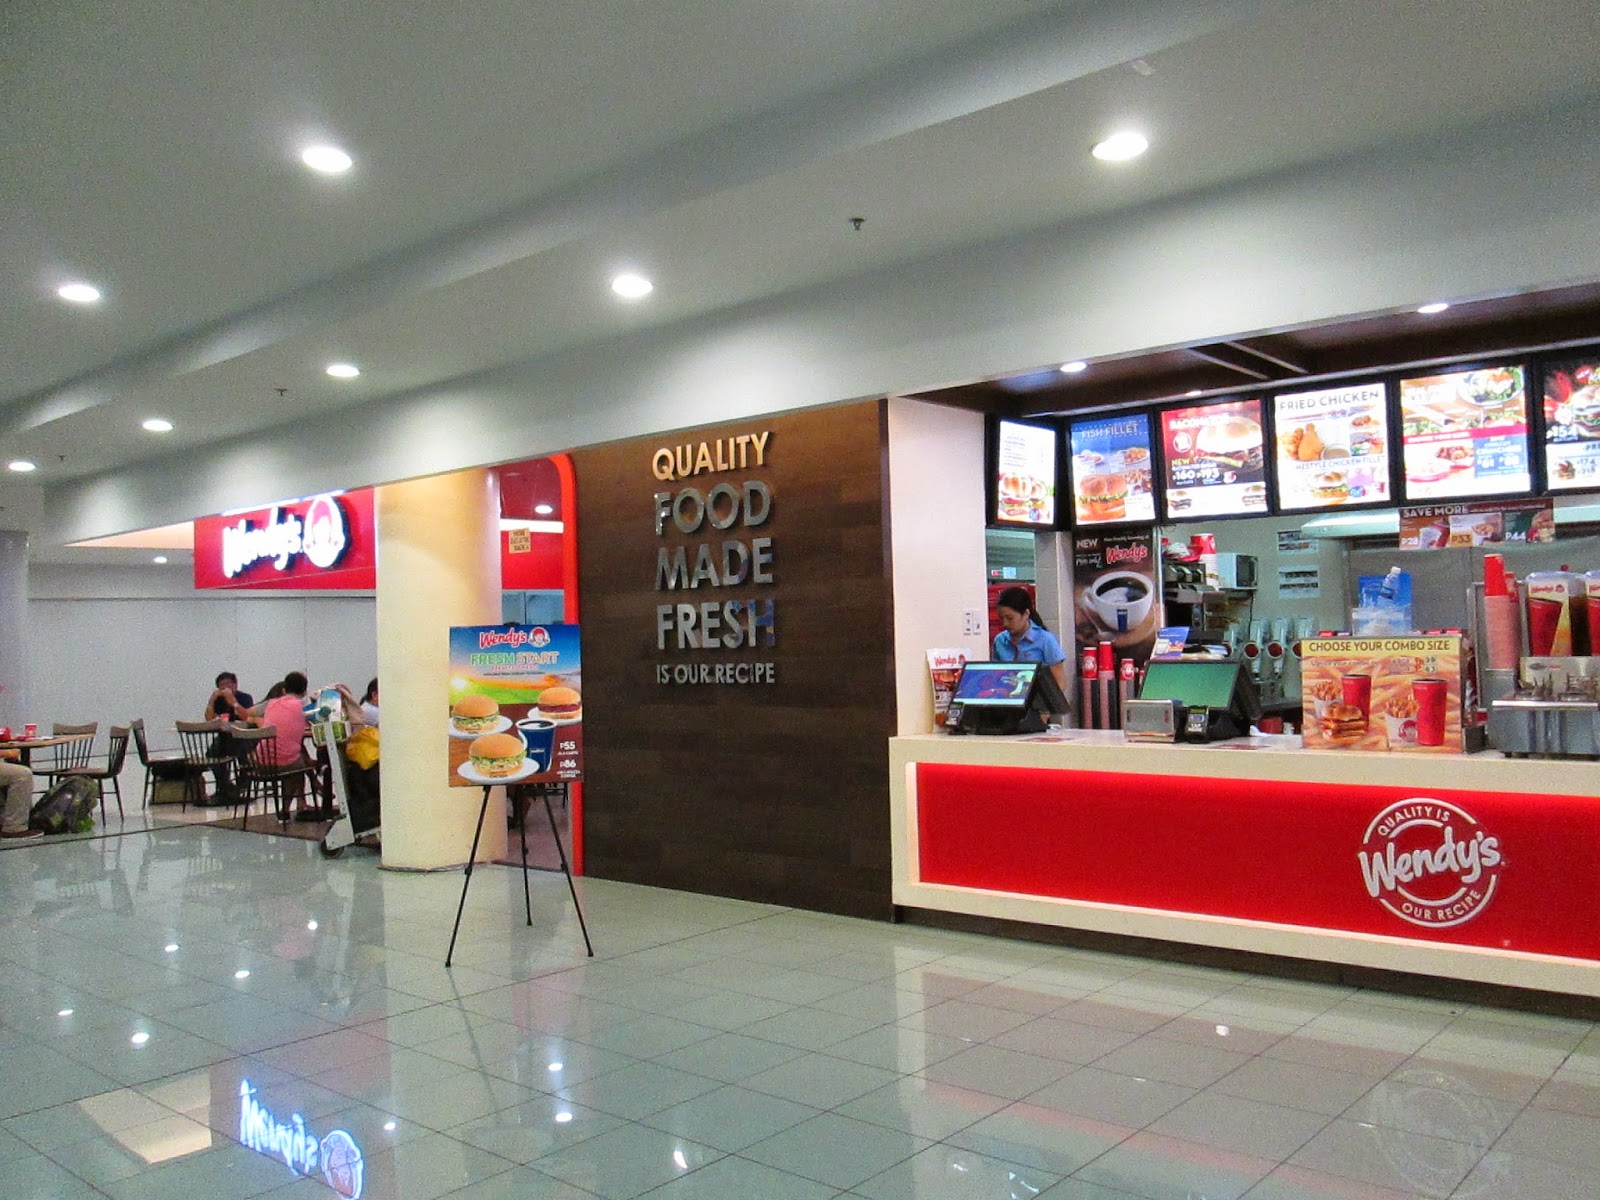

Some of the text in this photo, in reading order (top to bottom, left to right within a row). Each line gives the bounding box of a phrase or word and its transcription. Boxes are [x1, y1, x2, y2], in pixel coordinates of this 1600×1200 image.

[1280, 391, 1379, 411] FRIED CHICKEN
[1081, 423, 1139, 439] FISH FILLET
[652, 431, 770, 481] QUALITY
[654, 480, 771, 536] FOOD
[1403, 508, 1432, 518] SAVE
[1434, 505, 1469, 516] MORE
[1076, 538, 1098, 548] NEW
[1106, 542, 1148, 565] Wendy's
[655, 537, 773, 590] MADE
[656, 599, 776, 650] FRESH
[479, 627, 528, 649] Wendy's
[1309, 640, 1450, 652] CHOOSE YOUR COMBO SIZE
[471, 650, 560, 666] FRESH START
[656, 662, 775, 684] IS OUR RECIPE
[559, 741, 576, 750] P55
[1377, 806, 1451, 837] QUALITY IS
[1357, 826, 1501, 898] Wendy's
[1401, 889, 1482, 921] OUR RECIPE
